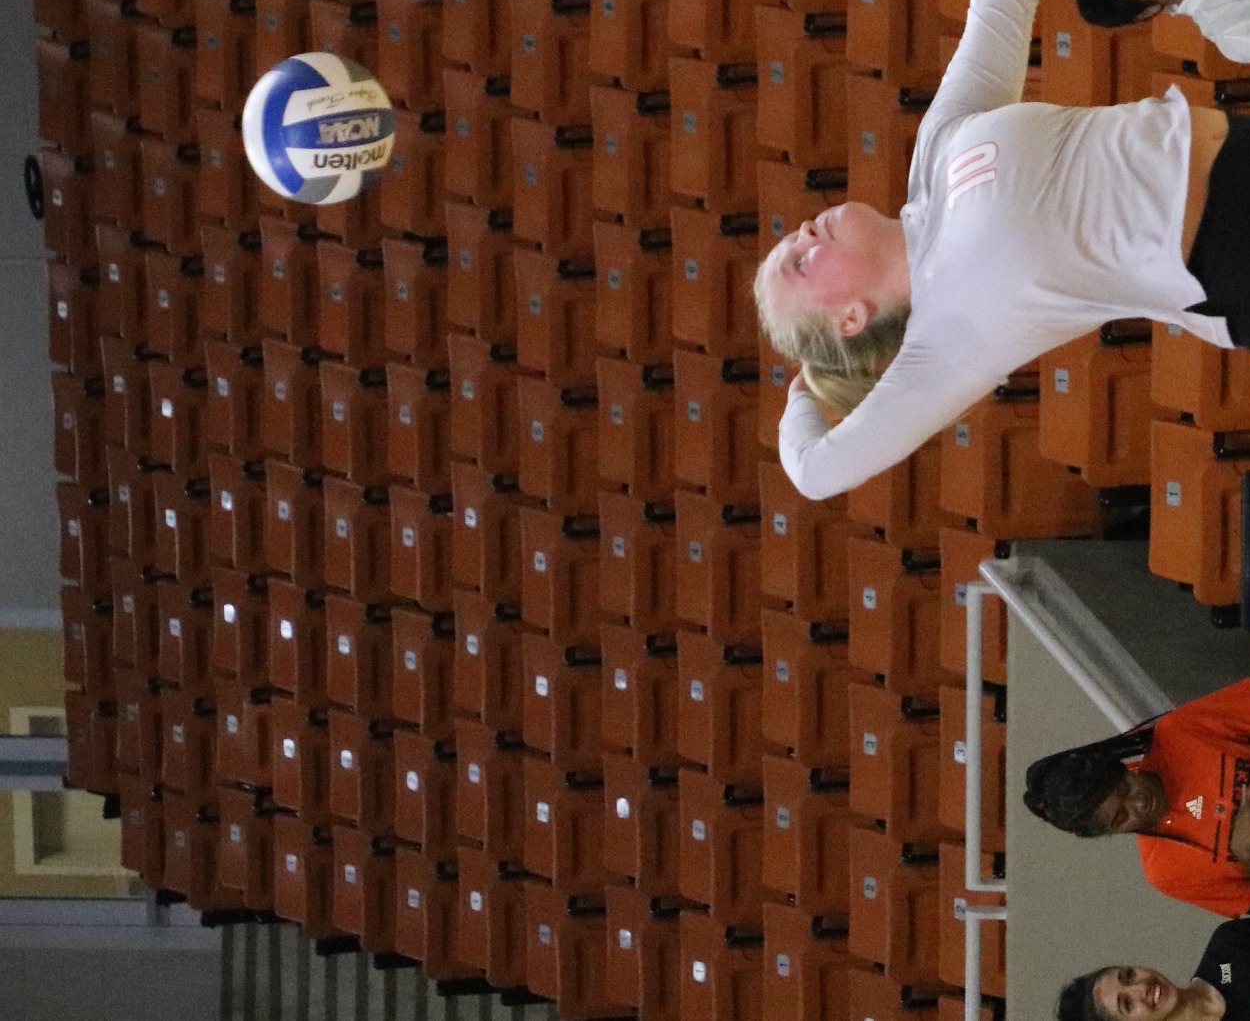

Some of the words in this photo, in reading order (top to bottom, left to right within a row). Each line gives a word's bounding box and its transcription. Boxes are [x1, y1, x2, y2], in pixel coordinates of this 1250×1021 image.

[318, 113, 380, 144] NCAA
[313, 141, 387, 170] molten
[945, 141, 999, 207] 10
